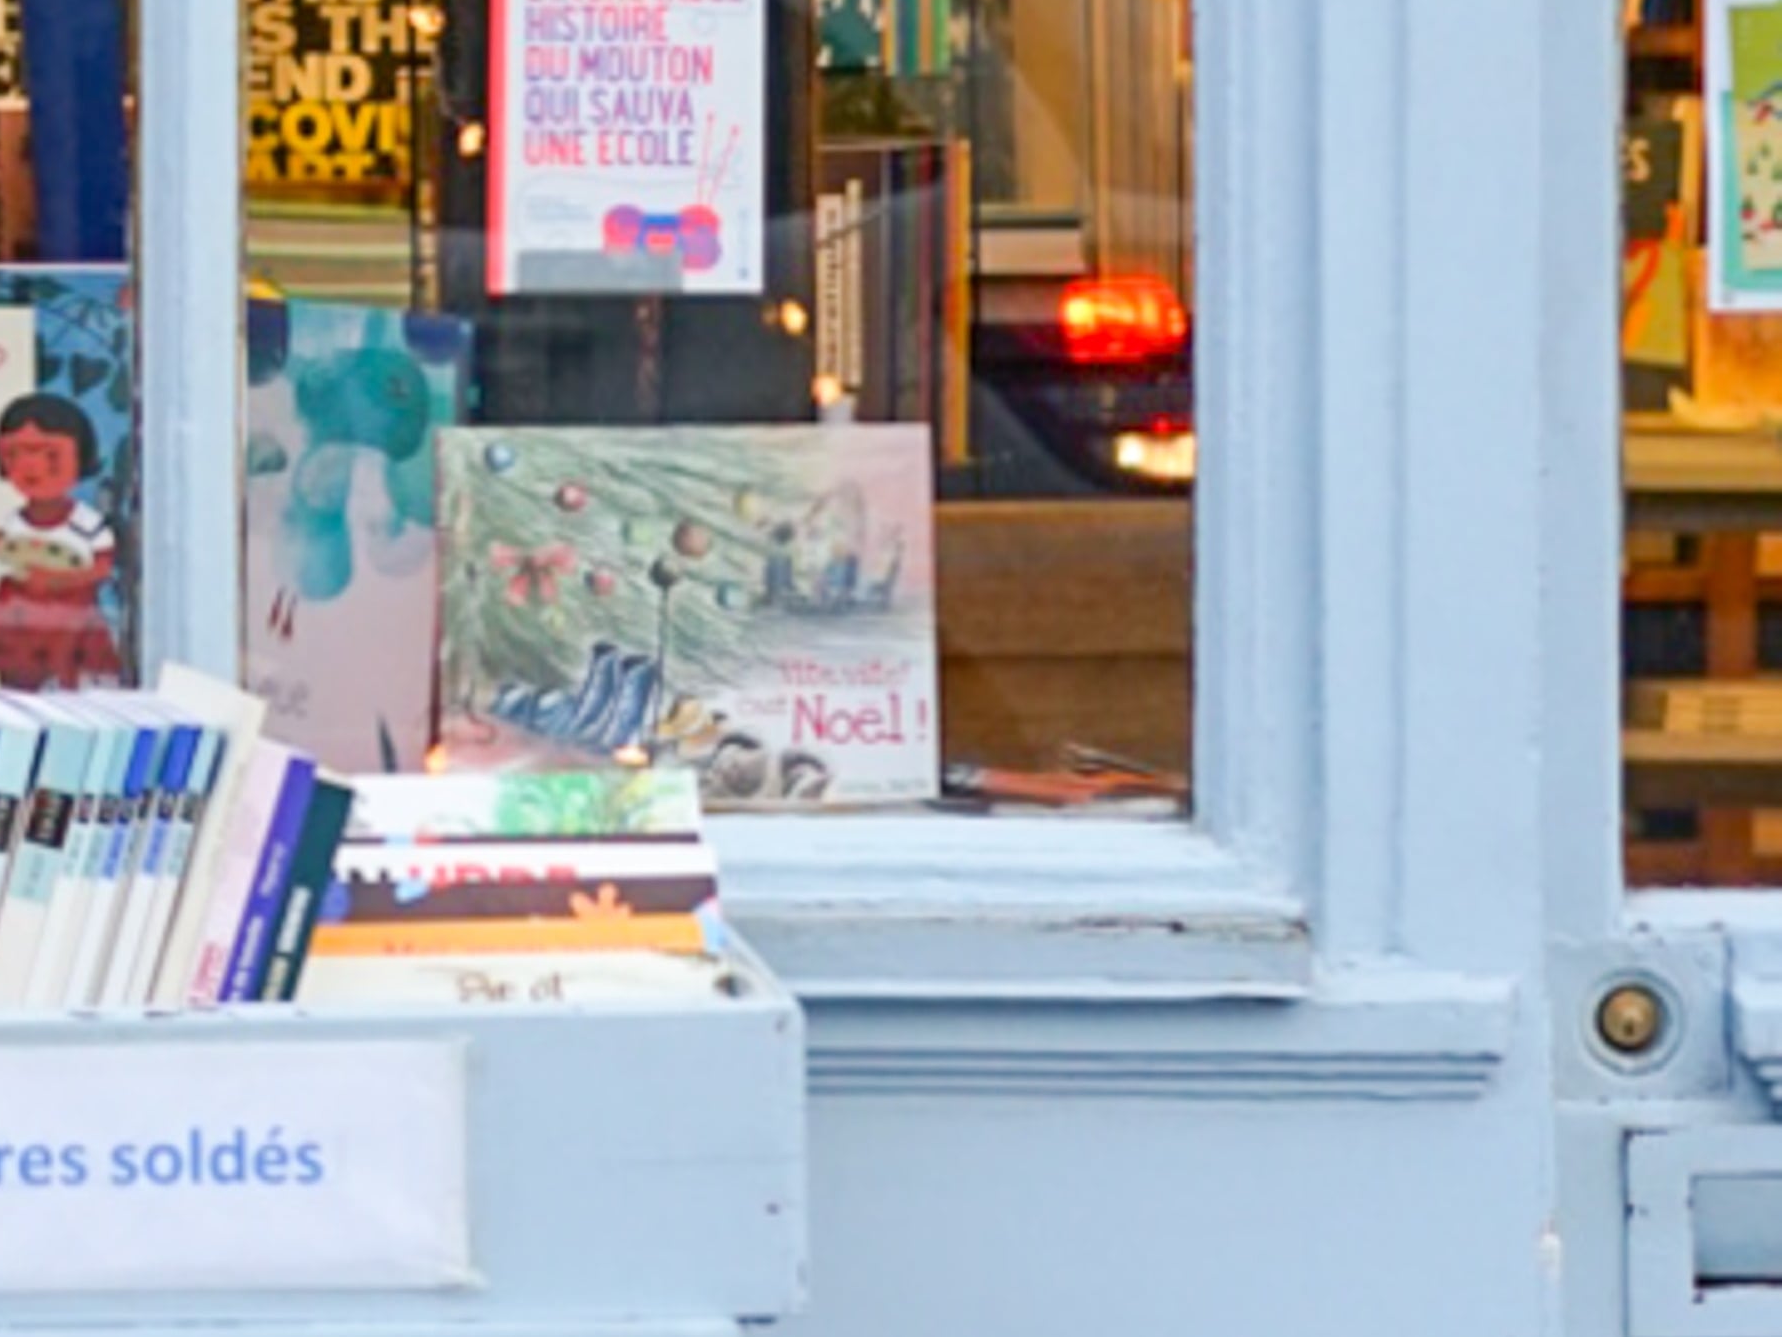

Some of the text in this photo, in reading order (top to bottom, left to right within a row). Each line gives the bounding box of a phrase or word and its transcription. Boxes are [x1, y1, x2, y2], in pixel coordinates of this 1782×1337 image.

[525, 6, 669, 42] HISTOIRE
[525, 46, 714, 85] DU MOUTON
[524, 87, 694, 125] QUI SAUVA
[524, 129, 586, 167] UNE
[111, 1126, 325, 1186] soldés
